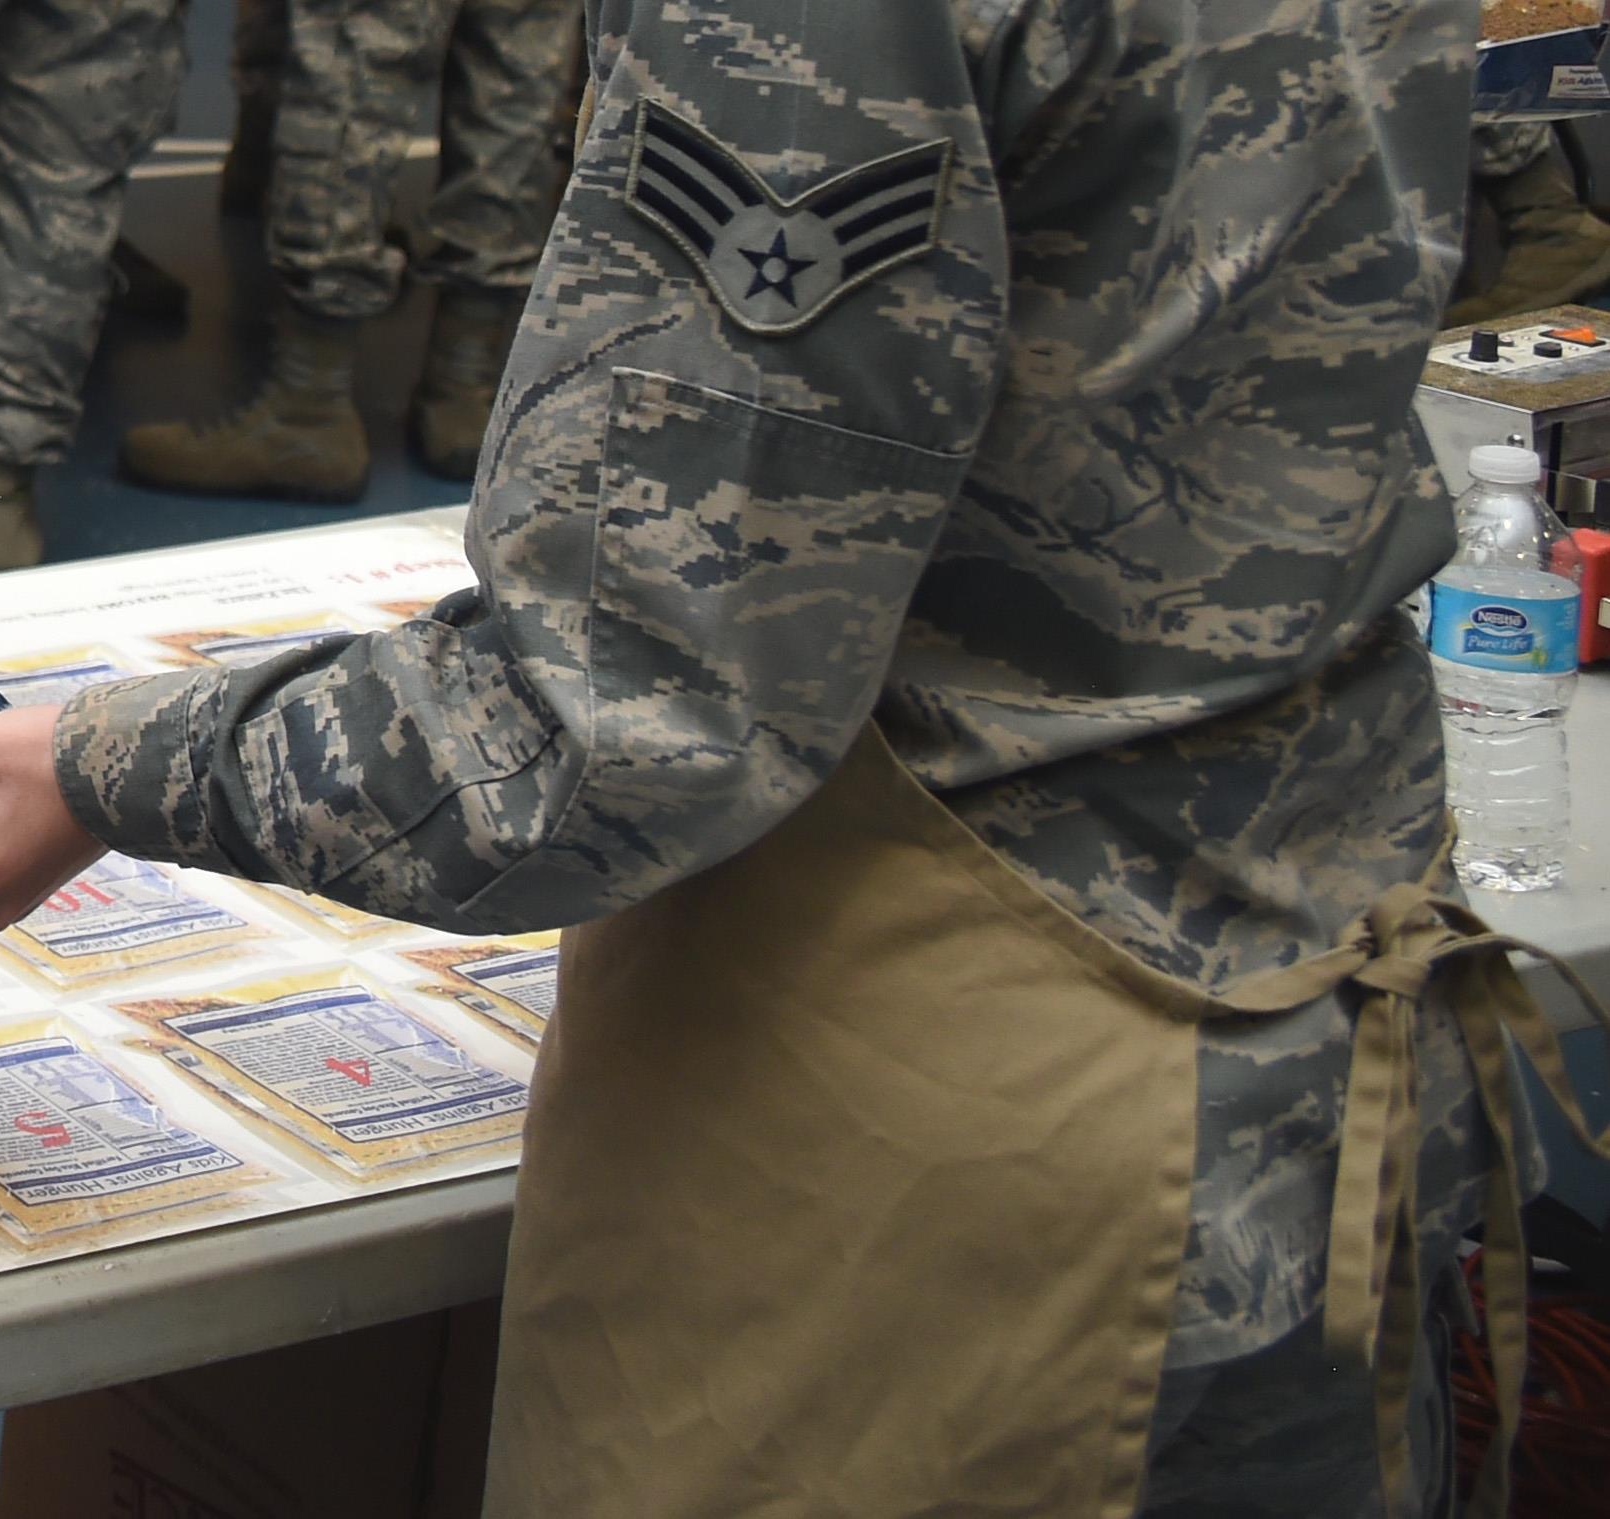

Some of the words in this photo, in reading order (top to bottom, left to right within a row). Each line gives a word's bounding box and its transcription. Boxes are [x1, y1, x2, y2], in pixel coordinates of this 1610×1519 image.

[1468, 636, 1500, 649] Pure
[1502, 637, 1528, 651] Life
[326, 1057, 372, 1088] 4
[498, 1092, 527, 1109] ids
[425, 1101, 496, 1124] Against
[14, 1111, 73, 1148] 5
[187, 1153, 228, 1168] Kids
[106, 1162, 183, 1187] Against
